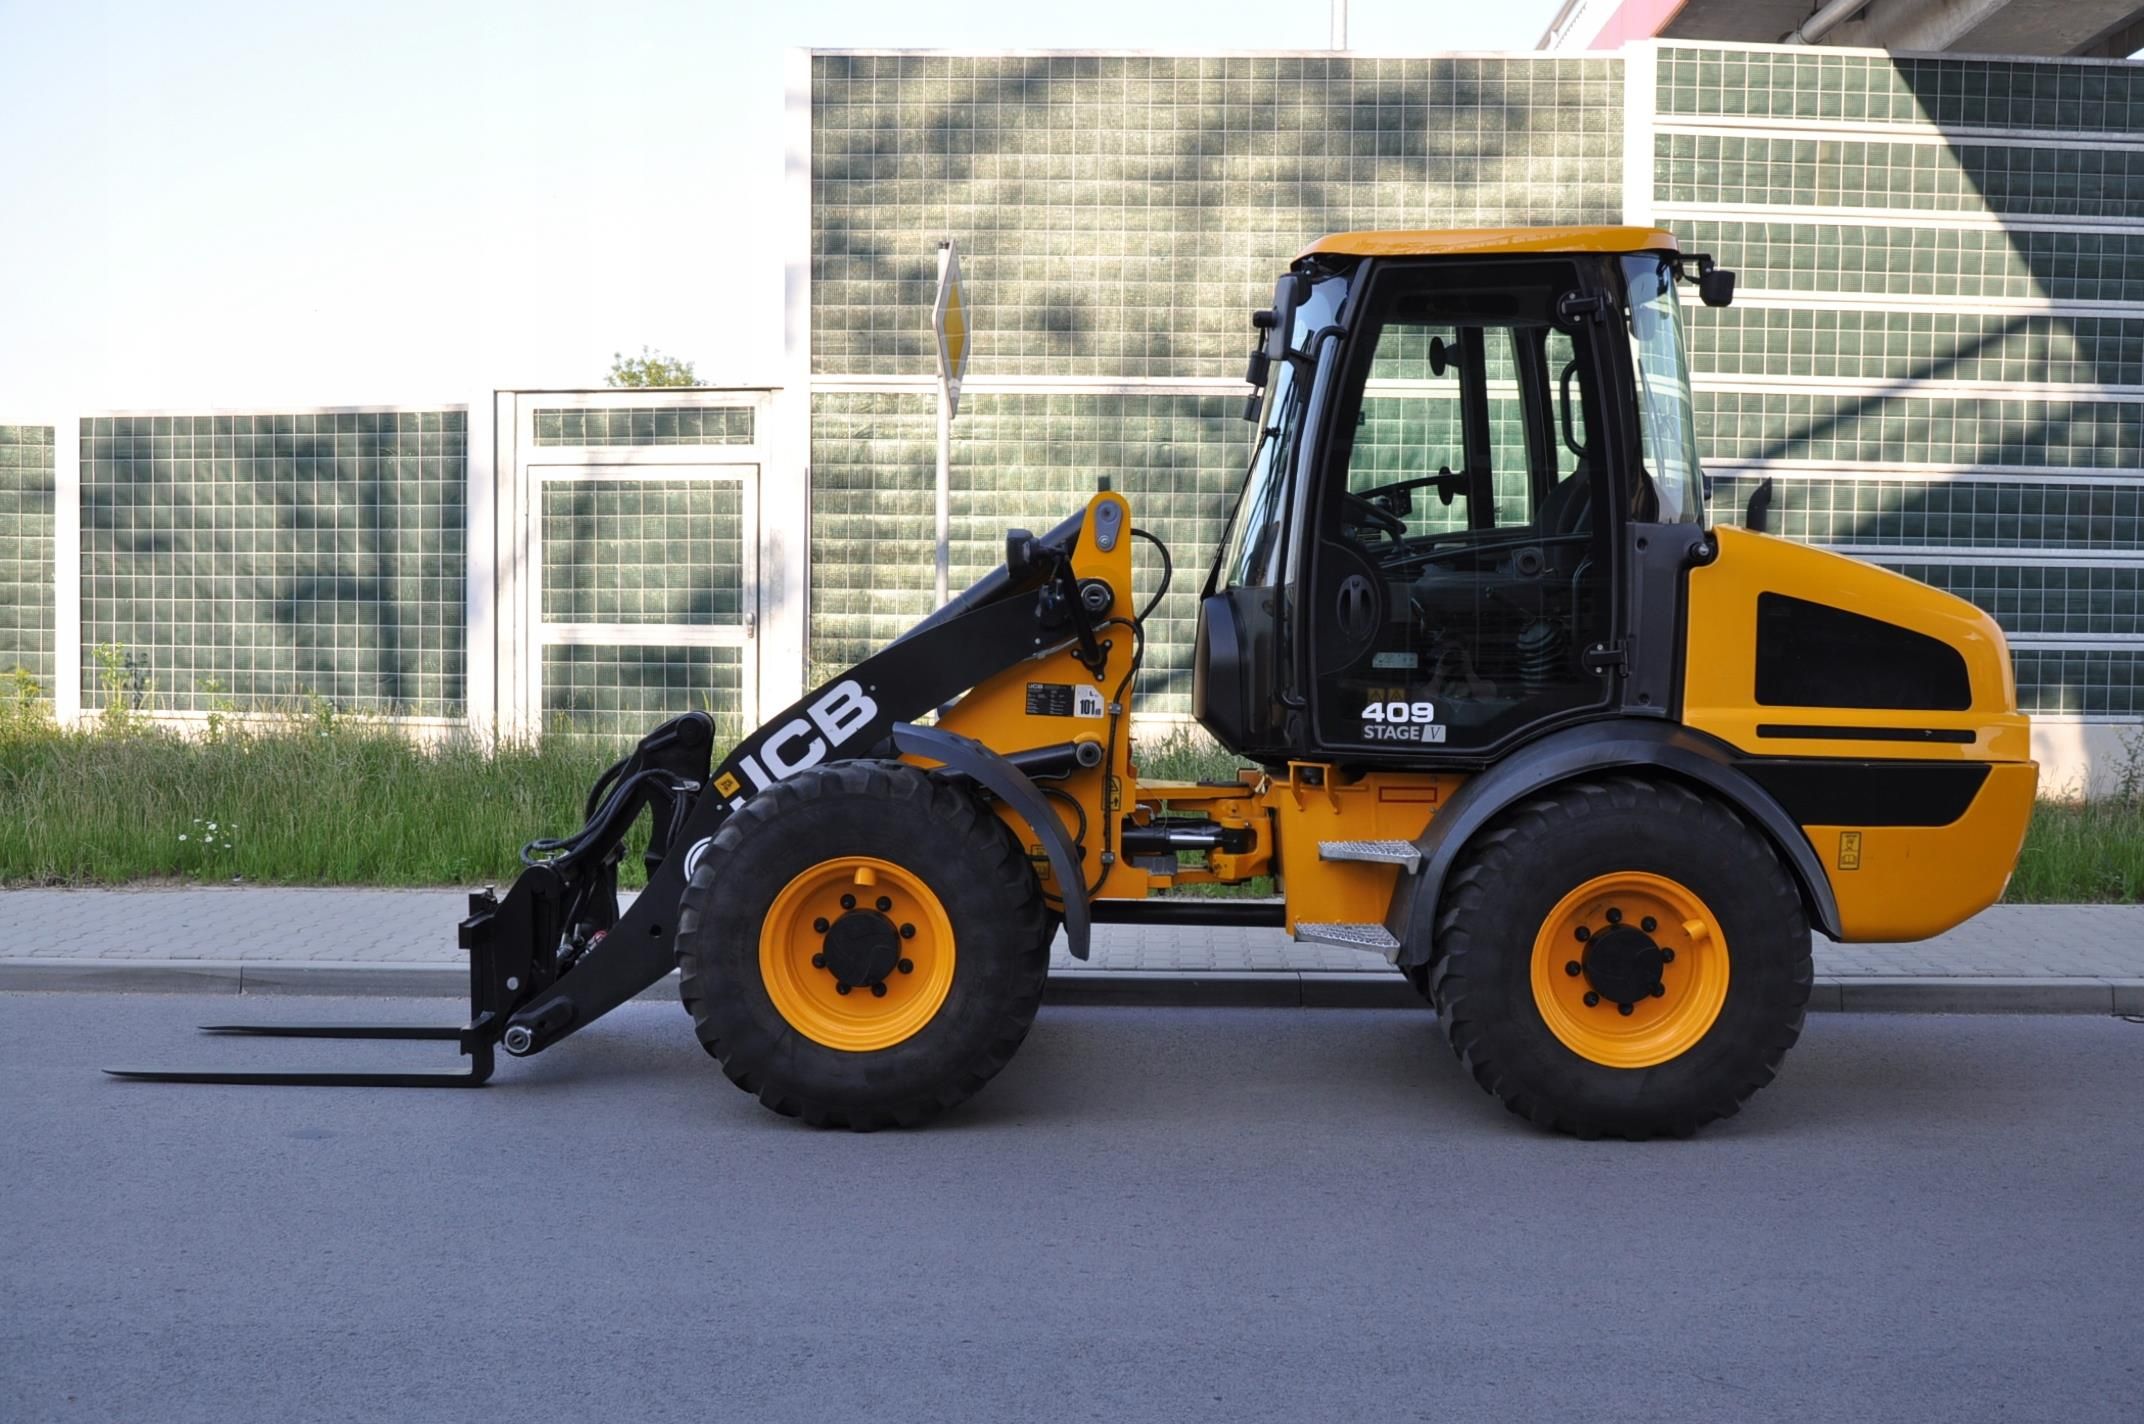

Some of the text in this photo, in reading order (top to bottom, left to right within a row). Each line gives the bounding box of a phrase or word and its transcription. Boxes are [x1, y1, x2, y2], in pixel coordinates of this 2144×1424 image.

[1080, 699, 1096, 715] 101
[1361, 702, 1434, 723] 409
[1363, 725, 1420, 740] STAGE
[729, 679, 878, 812] JCB
